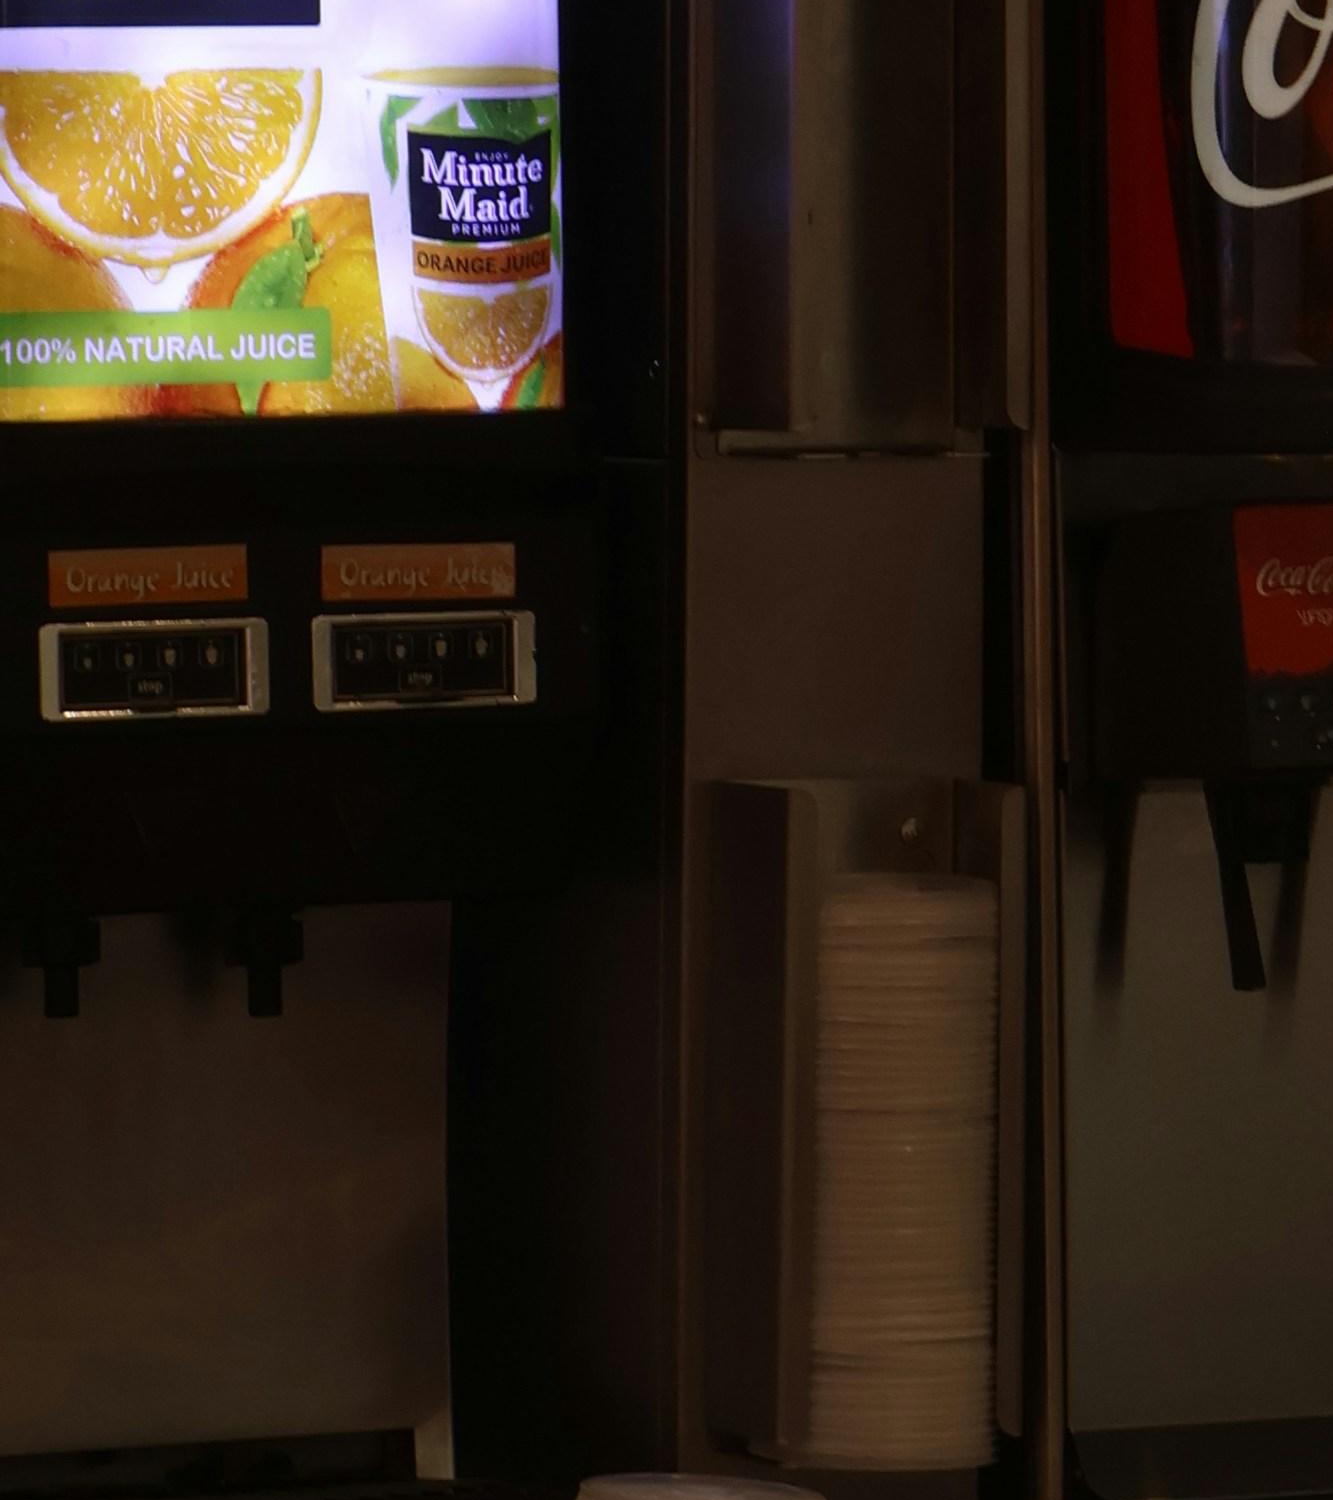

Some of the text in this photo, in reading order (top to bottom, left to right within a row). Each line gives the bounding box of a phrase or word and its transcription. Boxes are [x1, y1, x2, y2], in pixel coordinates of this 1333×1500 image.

[419, 145, 544, 188] Minute
[437, 183, 530, 224] Maid
[450, 222, 522, 238] PREMIUM
[416, 247, 550, 276] ORANGE JUICE
[1, 331, 316, 366] 100% NATURAL JUICE
[65, 559, 235, 601] Orange Juice
[339, 558, 431, 594] Orange
